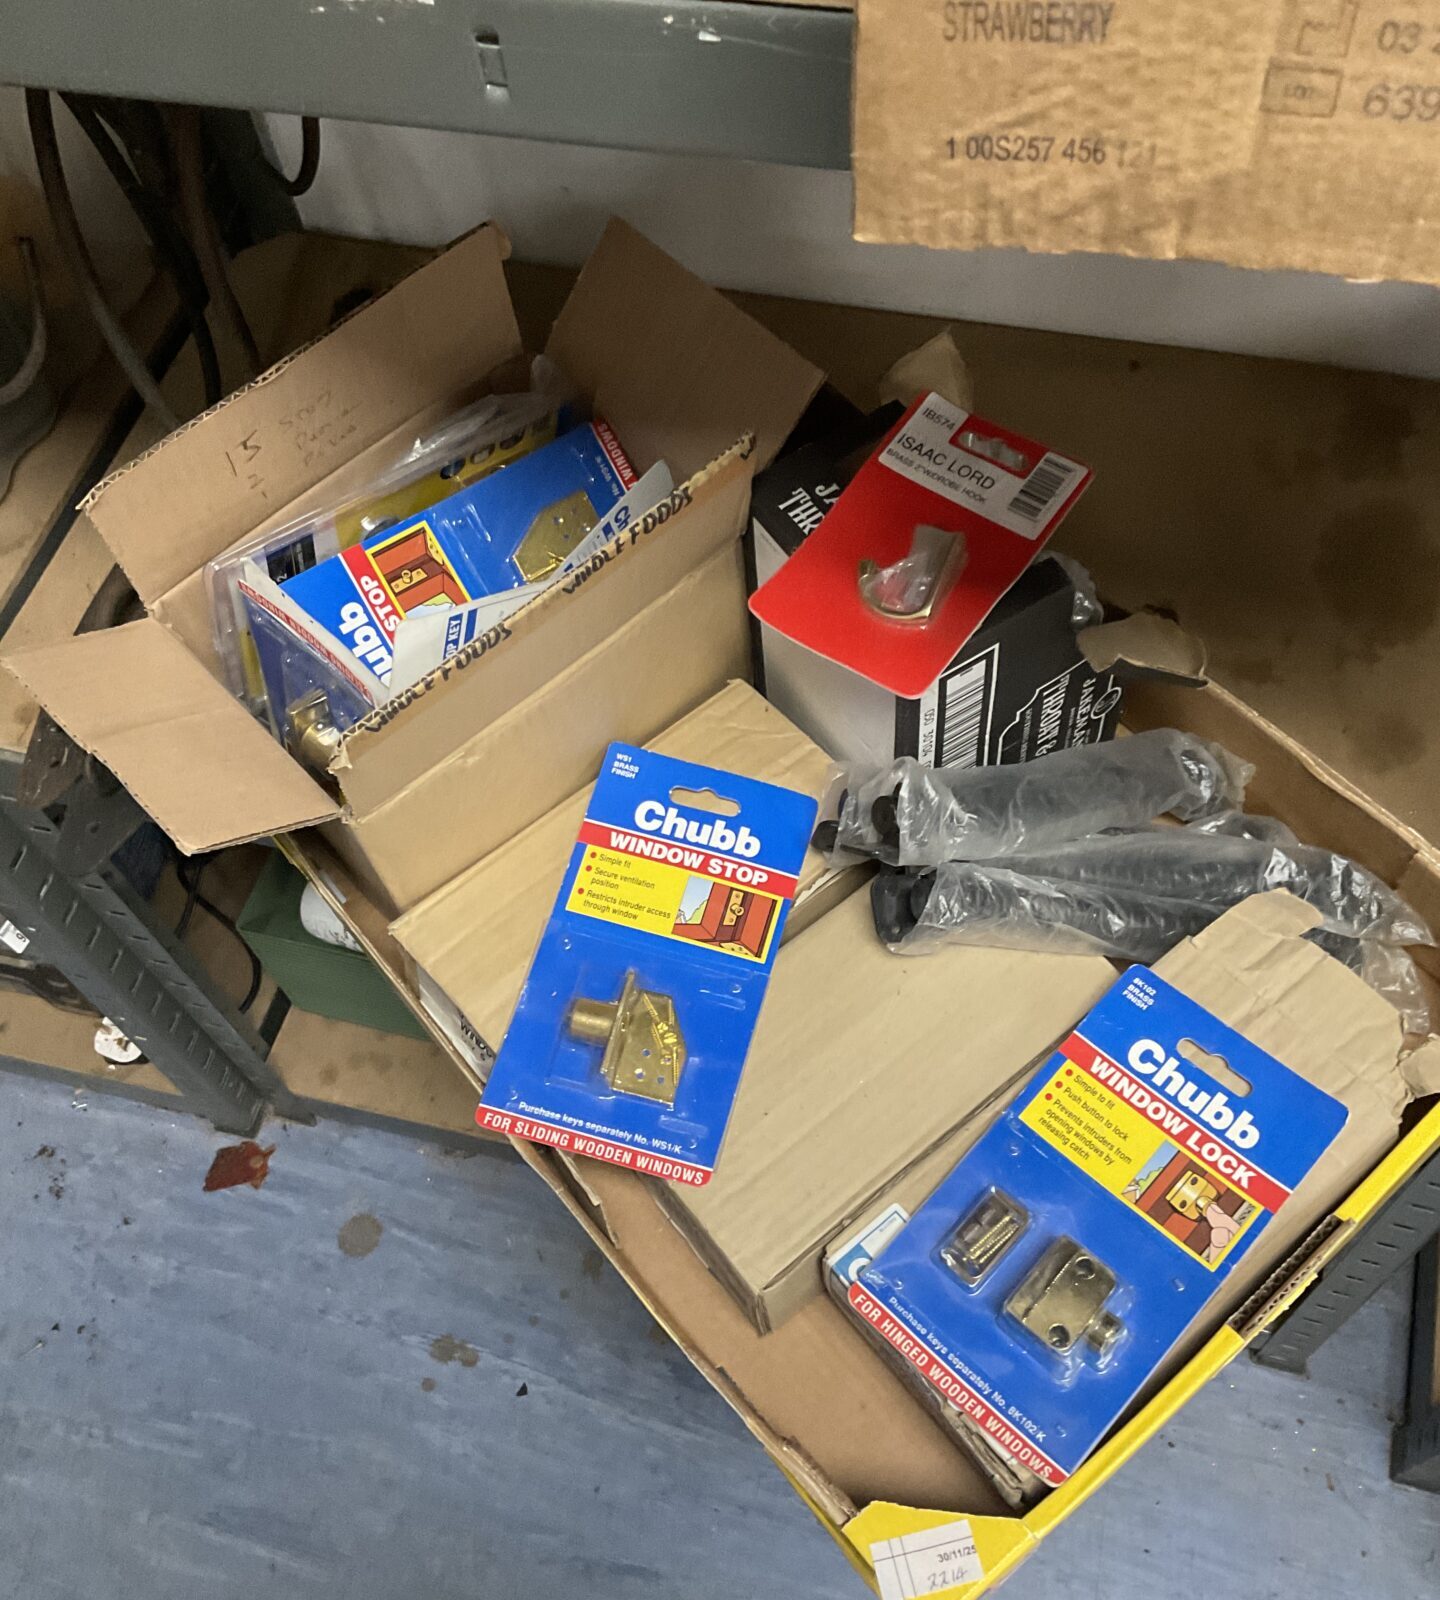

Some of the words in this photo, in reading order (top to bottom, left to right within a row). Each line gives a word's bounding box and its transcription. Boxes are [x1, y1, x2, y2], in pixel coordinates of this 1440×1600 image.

[943, 0, 1116, 42] STRAWBERRY
[1061, 138, 1106, 165] 456
[922, 407, 956, 431] IB574
[598, 423, 634, 480] WINDOWS
[897, 433, 947, 466] ISAAC
[947, 459, 996, 490] LORD
[360, 575, 400, 632] STOP
[448, 619, 460, 641] KEY
[1037, 674, 1070, 745] THROAT
[611, 767, 636, 779] FINISH
[613, 760, 640, 773] BRASS
[616, 752, 632, 763] WS1
[634, 800, 761, 858] Chubb
[594, 867, 618, 879] Secure
[619, 874, 655, 889] ventilation
[599, 854, 622, 867] Simple
[624, 859, 632, 869] fit
[610, 831, 705, 869] WINDOW
[707, 858, 768, 886] STOP
[586, 889, 617, 904] Restricts
[618, 897, 647, 911] intruder
[646, 906, 671, 919] access
[590, 877, 620, 890] position
[583, 899, 611, 914] through
[611, 907, 639, 920] window
[1122, 990, 1148, 1010] FINISH
[1127, 984, 1155, 1006] BRASS
[1073, 1075, 1098, 1096] Simple
[1097, 1094, 1106, 1103] to
[1105, 1100, 1116, 1110] fit
[1128, 1039, 1260, 1149] Chubb
[518, 1101, 561, 1121] Purchase
[561, 1113, 584, 1128] keys
[585, 1121, 632, 1143] separately
[634, 1133, 649, 1145] No.
[652, 1138, 683, 1154] WS1/K
[1053, 1098, 1084, 1126] Prevents
[1083, 1122, 1115, 1151] intruders
[1114, 1147, 1132, 1164] from
[1063, 1087, 1082, 1104] Push
[1081, 1101, 1105, 1122] button
[1104, 1119, 1113, 1129] to
[1111, 1125, 1128, 1141] lock
[1089, 1055, 1189, 1136] WINDOW
[1186, 1131, 1258, 1189] LOCK
[483, 1112, 512, 1133] FOR
[514, 1121, 570, 1147] SLIDING
[573, 1137, 632, 1165] WOODEN
[636, 1155, 704, 1185] WINDOWS
[1038, 1117, 1070, 1146] releasing
[1069, 1142, 1090, 1160] catch
[1046, 1109, 1074, 1134] opening
[1074, 1131, 1104, 1157] windows
[1104, 1153, 1116, 1166] by
[889, 1296, 927, 1335] Purchase
[927, 1332, 948, 1354] keys
[947, 1353, 992, 1395] separately
[991, 1391, 1006, 1409] No.
[853, 1293, 881, 1322] FOR
[880, 1318, 929, 1366] HINGED
[929, 1363, 986, 1419] WOODEN
[985, 1415, 1053, 1478] WINDOWS
[937, 1545, 977, 1563] 30/11/25
